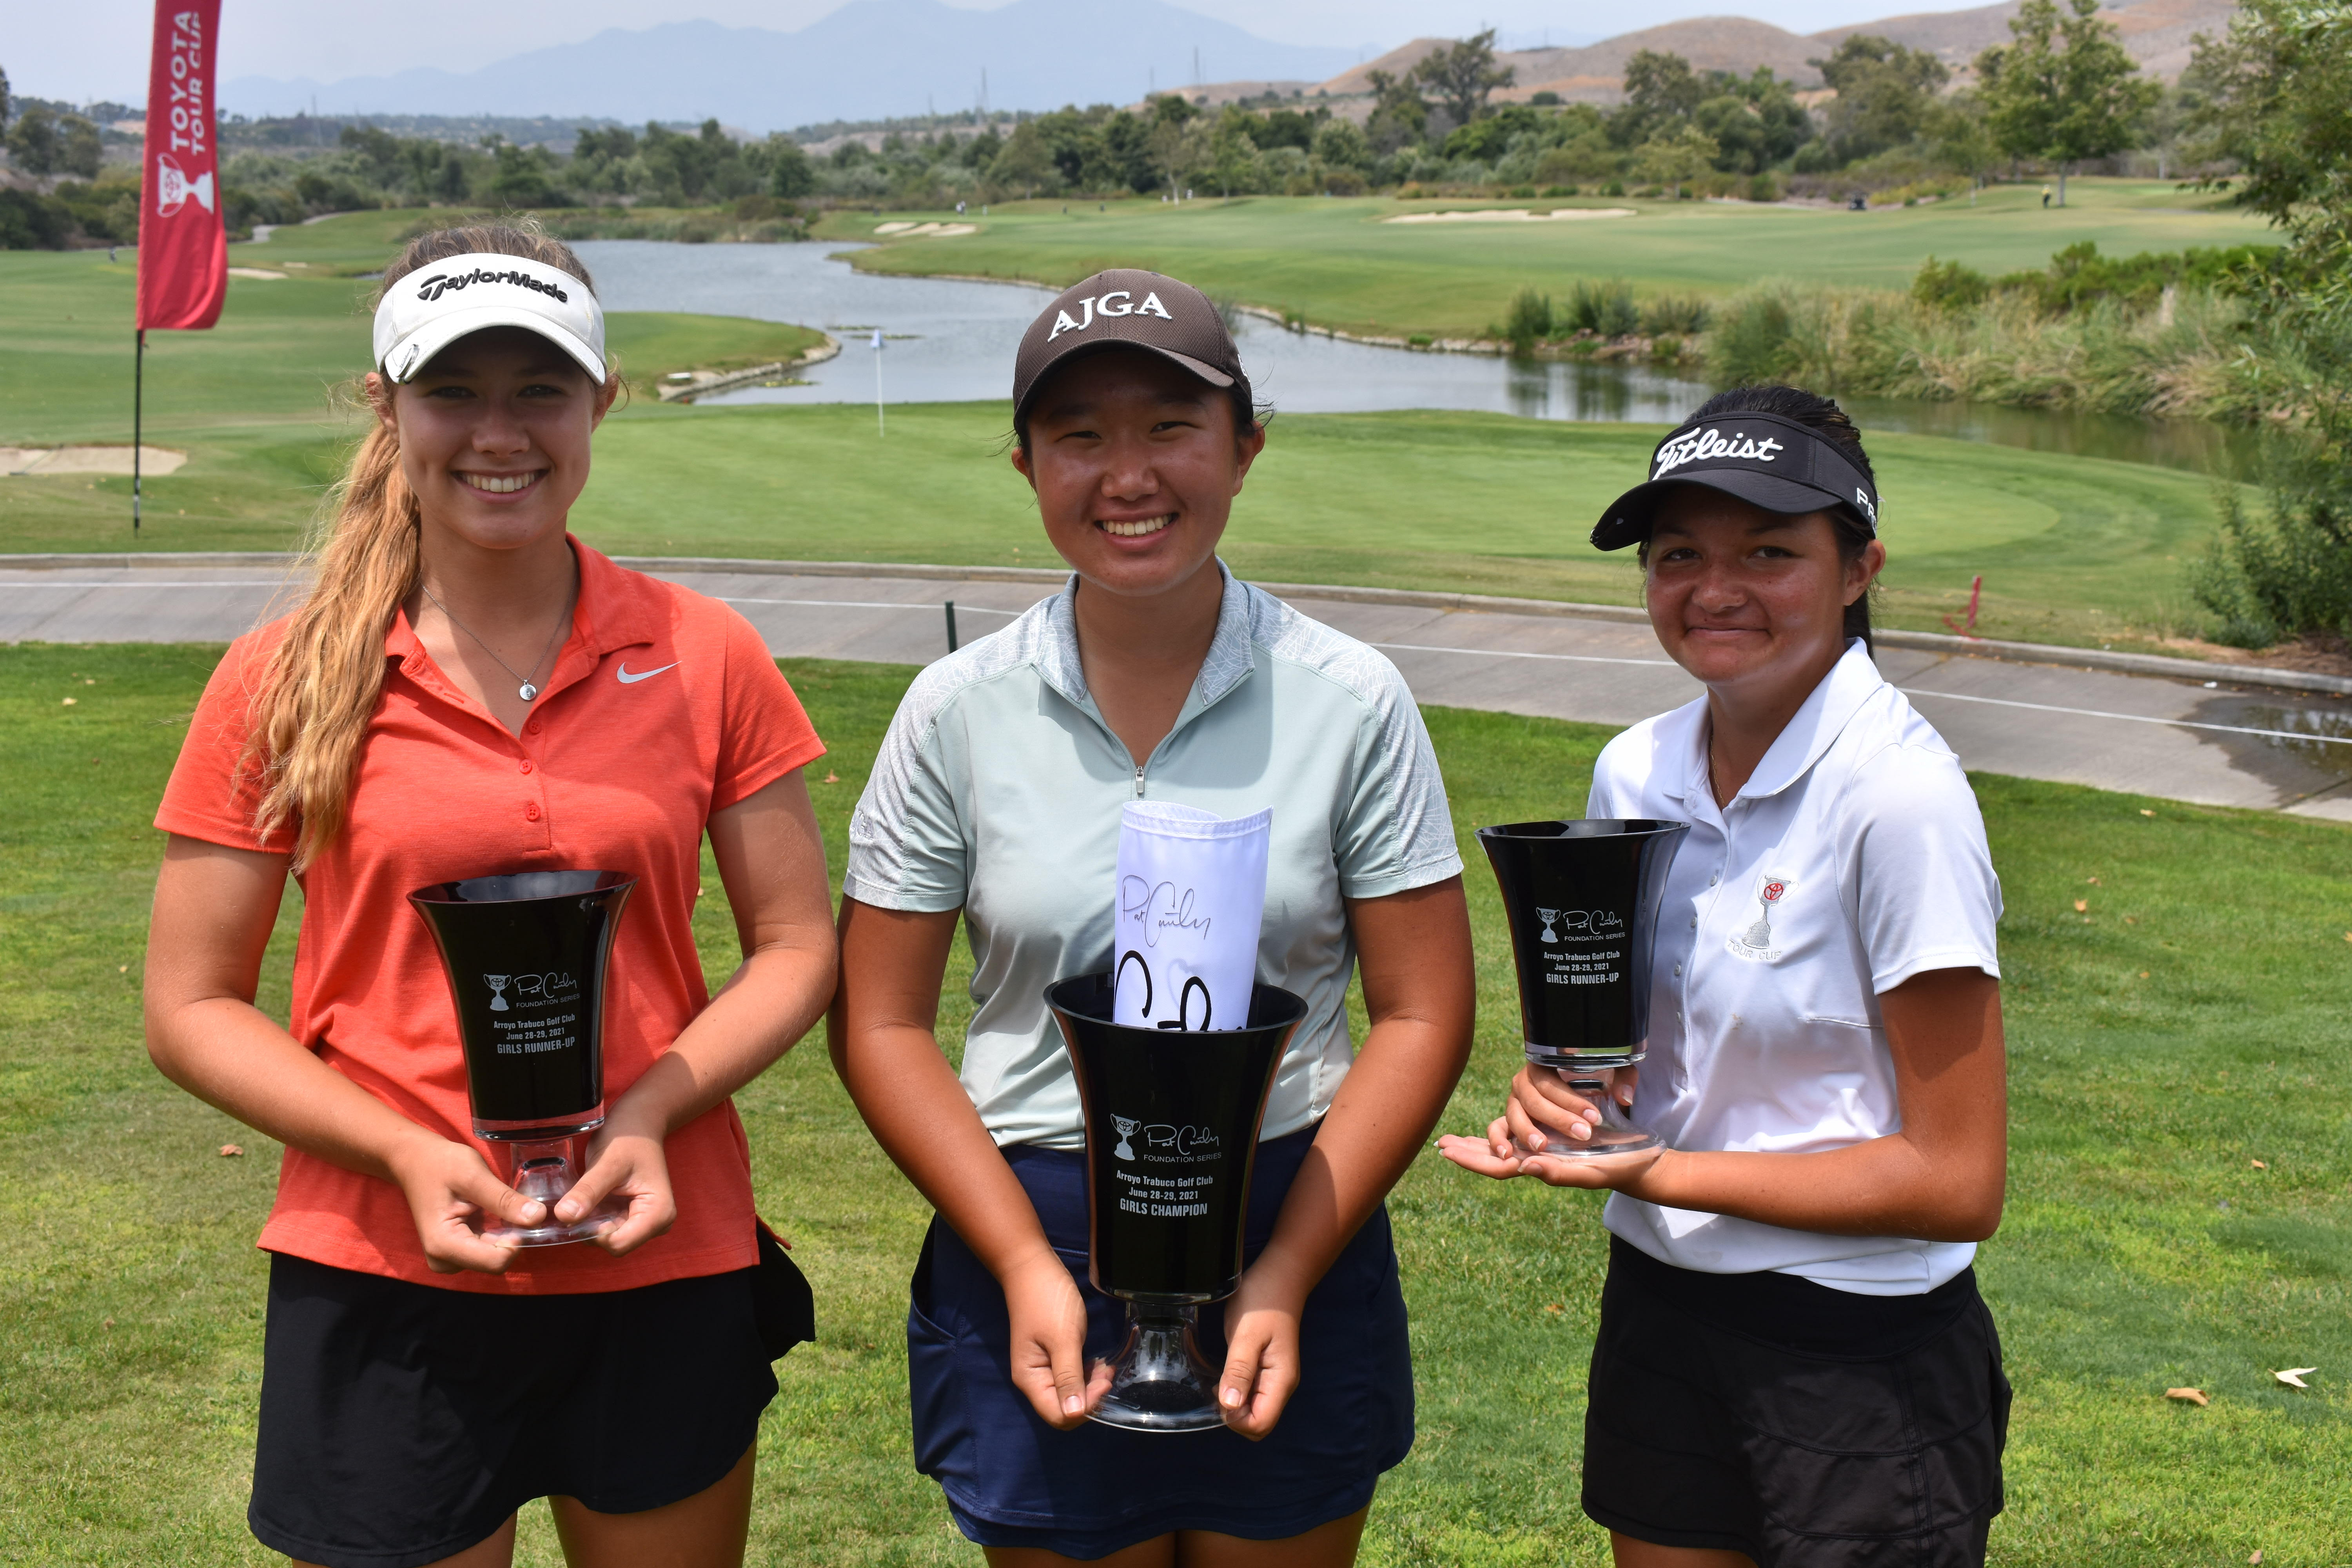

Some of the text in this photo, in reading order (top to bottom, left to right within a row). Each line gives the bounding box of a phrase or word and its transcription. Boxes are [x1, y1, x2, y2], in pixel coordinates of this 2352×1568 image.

[170, 11, 190, 152] TOYOTA
[188, 11, 206, 156] TOUR CUP
[417, 268, 568, 301] TaylorMade
[1047, 291, 1172, 343] AJGA
[1652, 427, 1784, 481] Titleist
[1544, 951, 1564, 962] Arroyo
[1606, 950, 1620, 959] Club
[1727, 938, 1782, 960] TOUR CUP
[1571, 964, 1592, 972] 28-29,
[1594, 962, 1609, 971] 2021
[1546, 972, 1619, 984] GIRLS RUNNER-UP
[516, 993, 580, 1008] FOUNDATION SERIES
[494, 1021, 515, 1030] Arroyo
[547, 1016, 560, 1025] Golf
[562, 1014, 575, 1023] Club
[525, 1030, 548, 1039] 28-29,
[549, 1027, 564, 1036] 2021
[497, 1036, 575, 1054] GIRLS RUNNER-UP
[1144, 1152, 1222, 1163] FOUNDATION SERIES
[1116, 1170, 1213, 1187] Arroyo Trabuco Golf Club
[1129, 1187, 1198, 1201] June 28-29, 2021
[1120, 1198, 1207, 1217] GIRLS CHAMPION
